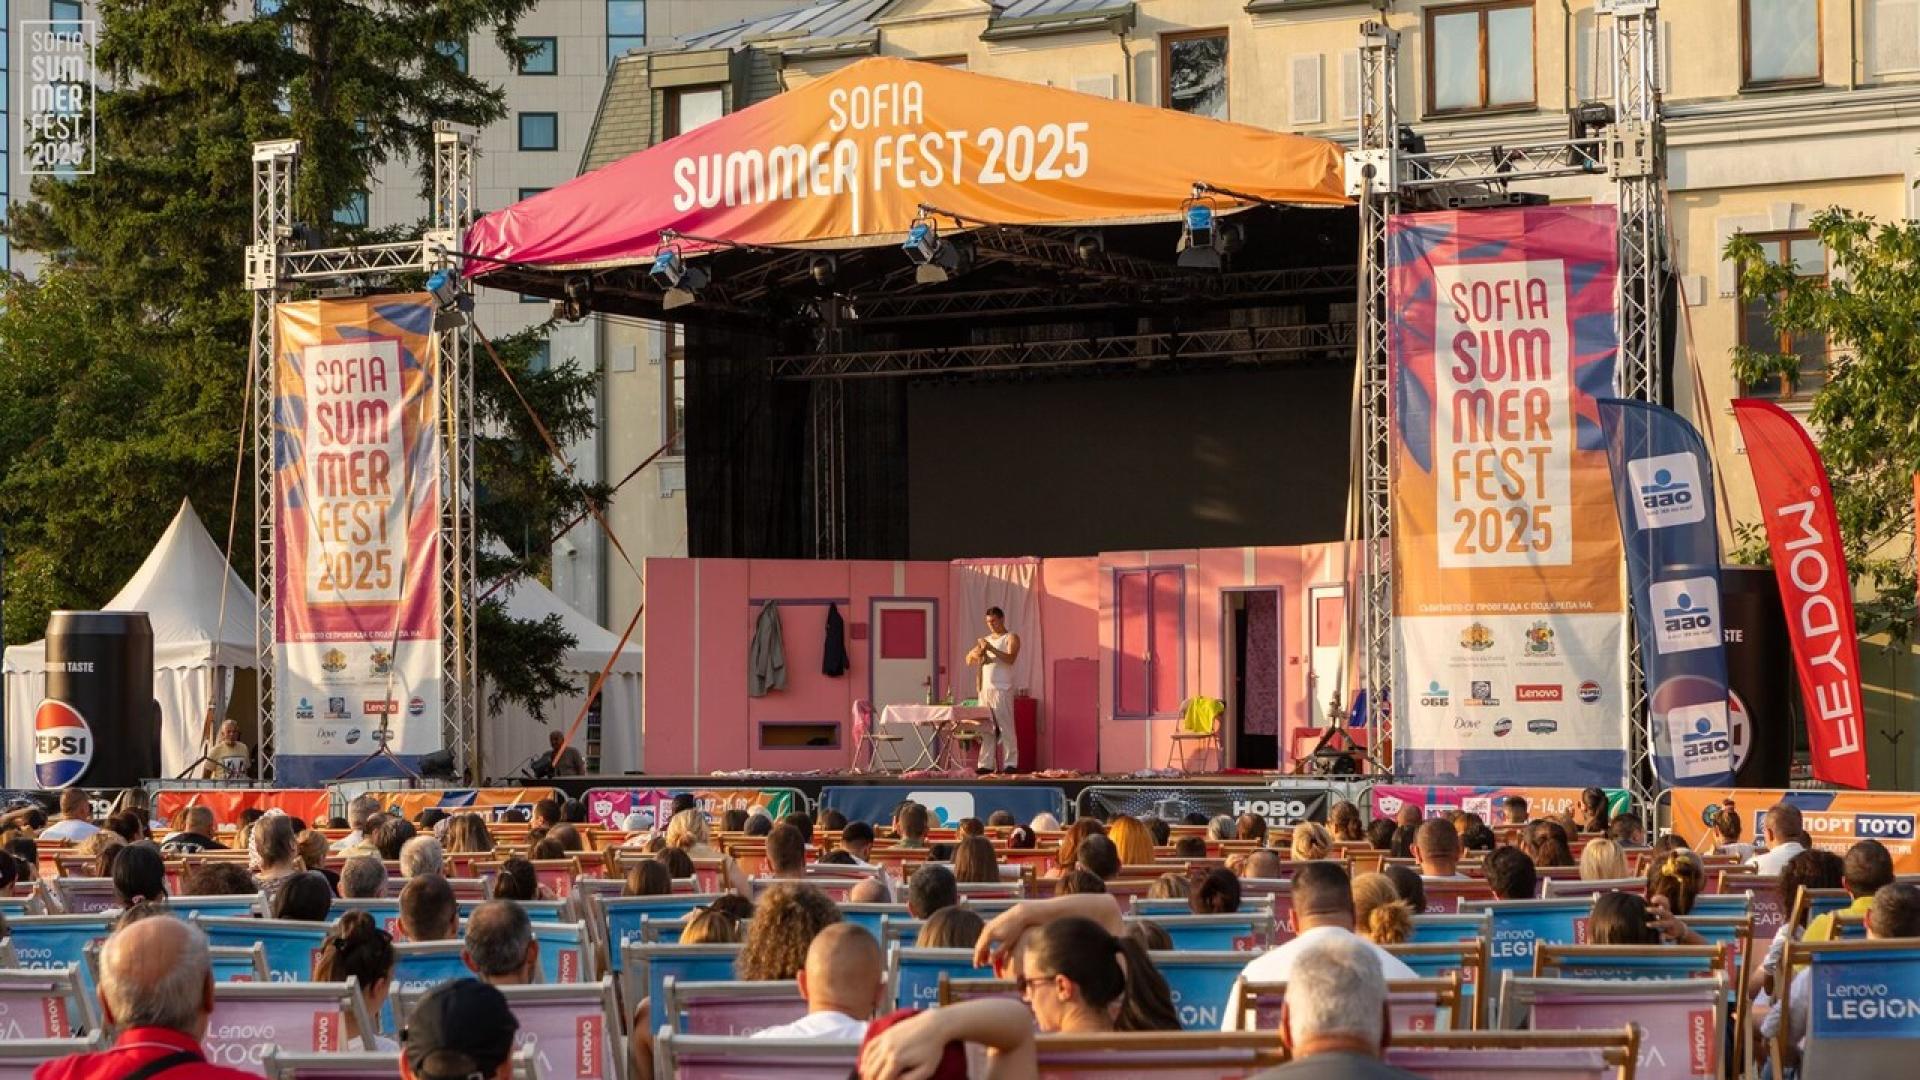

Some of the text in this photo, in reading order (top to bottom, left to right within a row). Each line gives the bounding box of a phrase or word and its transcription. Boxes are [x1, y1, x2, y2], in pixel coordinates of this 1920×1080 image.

[828, 81, 923, 132] SOFIA
[673, 122, 1089, 222] SUMMER FEST 2025
[1450, 278, 1549, 325] SOFIA
[315, 356, 388, 396] SOFIA
[1451, 328, 1551, 385] SUM
[316, 400, 389, 446] SUM
[1452, 387, 1552, 444] MER
[317, 450, 391, 498] MER
[1452, 446, 1552, 502] FEST
[318, 500, 392, 547] FEST
[1453, 505, 1553, 555] 2025
[317, 549, 393, 592] 2025
[67, 662, 94, 673] TASTE
[1519, 688, 1559, 698] Lenovo
[1803, 817, 1912, 834] ПОРТ ТОТО
[1826, 983, 1888, 997] Lenovo
[207, 1021, 275, 1039] Lenovo
[319, 1017, 328, 1053] novo
[581, 1020, 592, 1075] Lenovo
[1694, 1016, 1705, 1071] Lenovo
